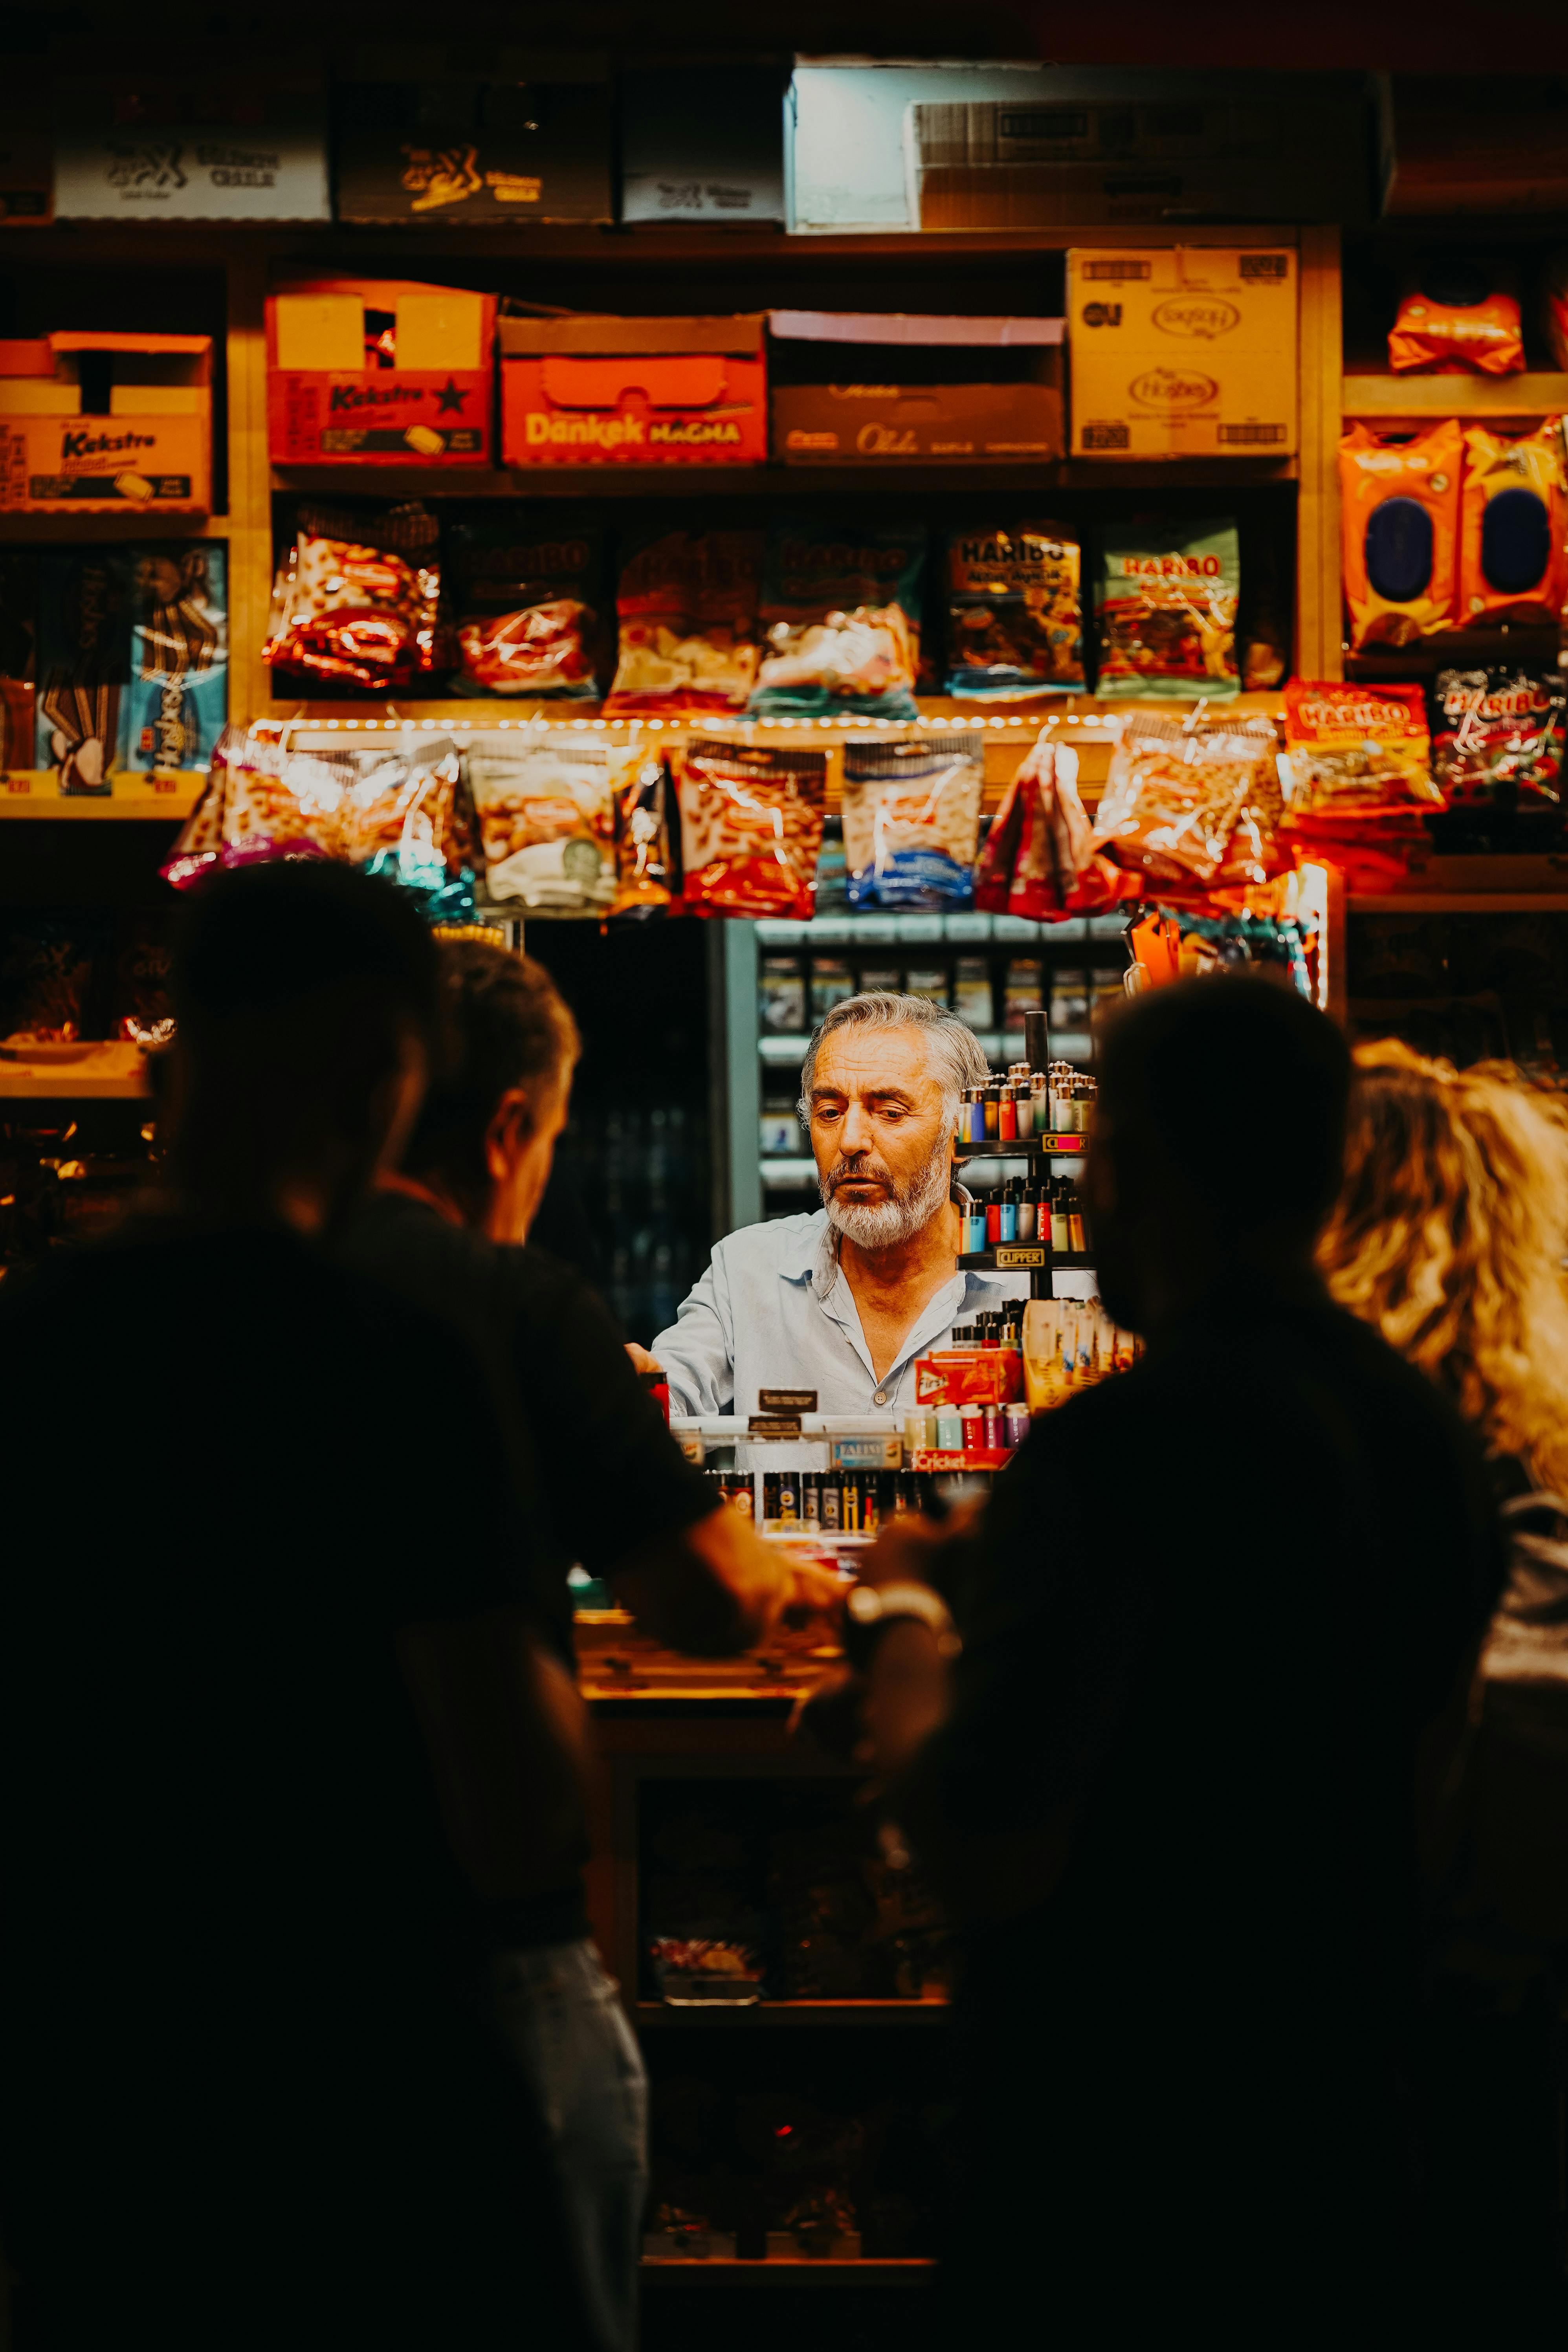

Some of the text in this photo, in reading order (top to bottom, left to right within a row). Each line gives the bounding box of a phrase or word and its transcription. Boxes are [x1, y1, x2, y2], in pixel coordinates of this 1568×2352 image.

[525, 413, 644, 448] Dankek
[963, 541, 1064, 562] HARIBO
[1124, 555, 1220, 577] HARIBO
[1301, 702, 1410, 728] HARIBO
[1001, 1252, 1040, 1263] CLIPPER
[918, 1453, 965, 1470] Cricket
